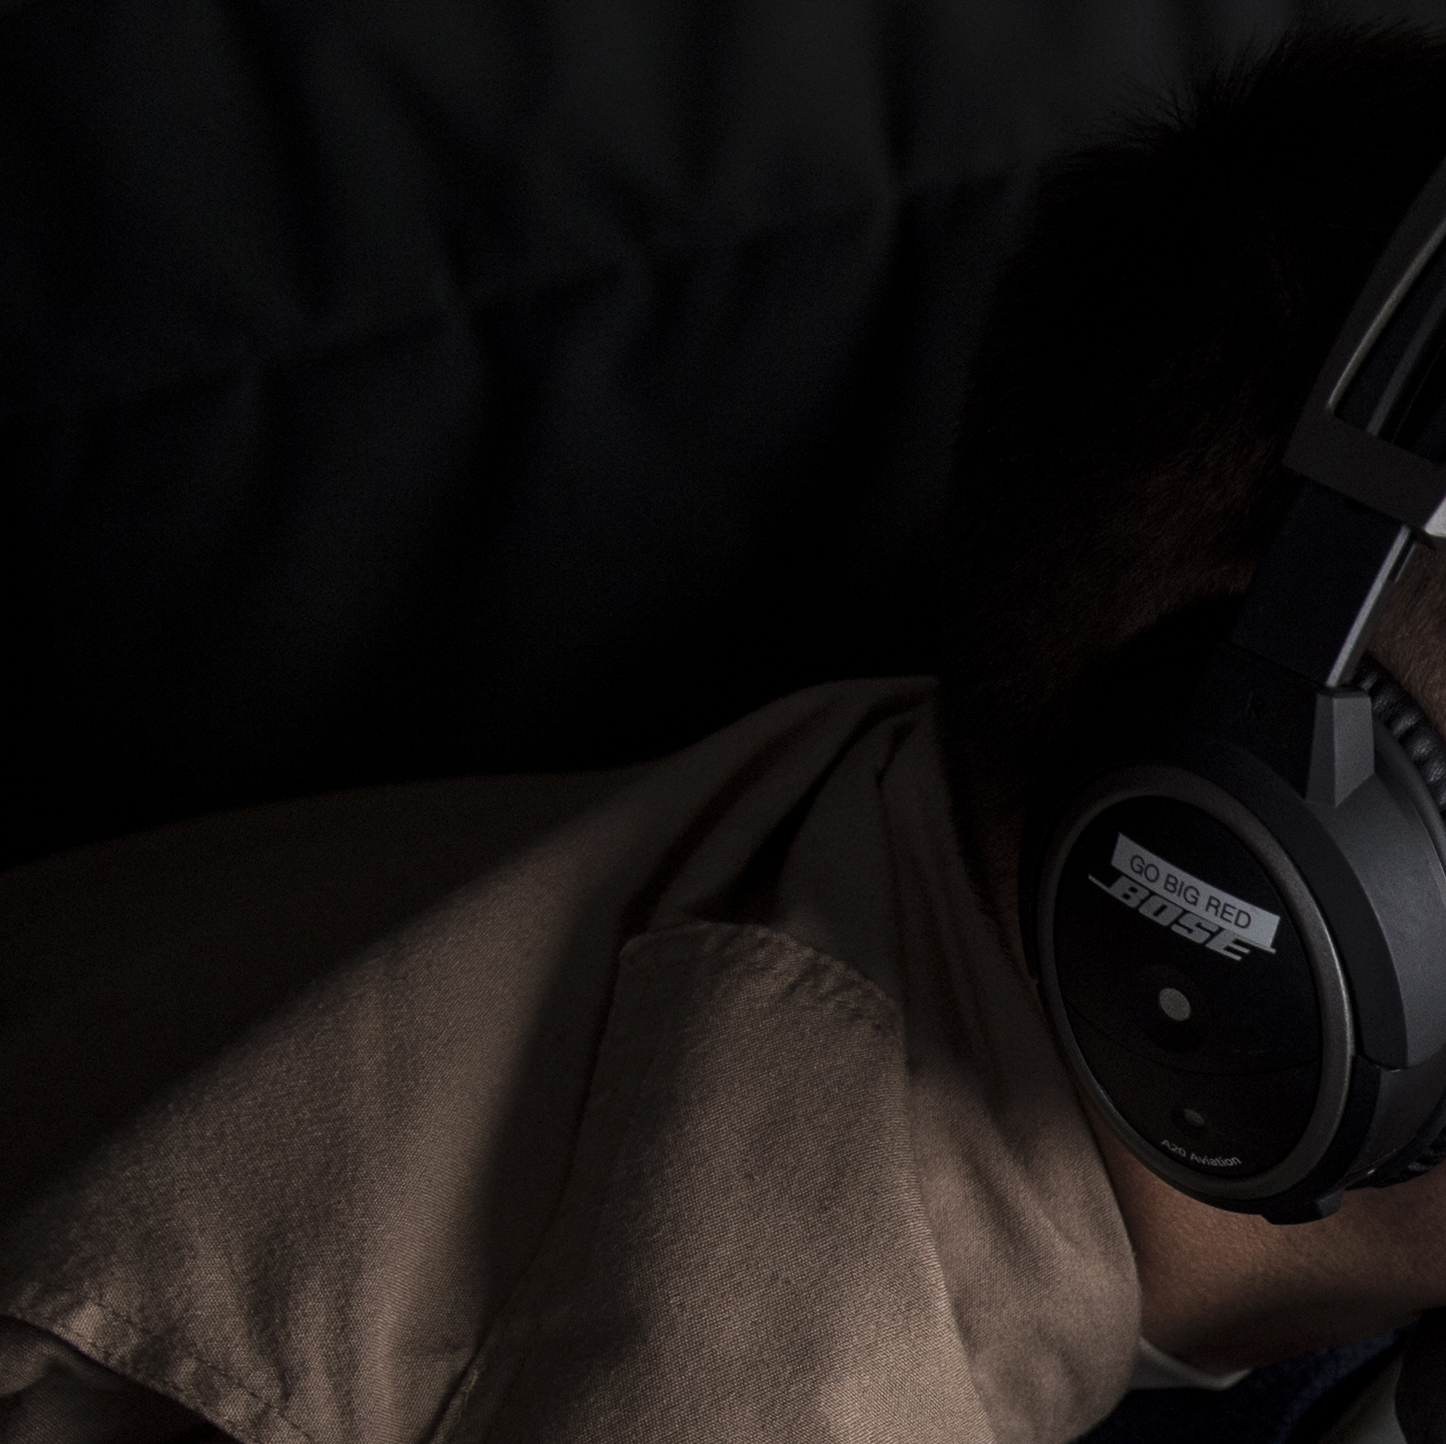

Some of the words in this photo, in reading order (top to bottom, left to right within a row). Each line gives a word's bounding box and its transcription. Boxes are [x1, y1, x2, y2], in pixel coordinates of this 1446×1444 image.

[1088, 873, 1277, 962] BOSE
[1129, 854, 1160, 883] GO
[1163, 873, 1200, 906] BIG
[1205, 895, 1252, 930] RED
[1161, 1139, 1187, 1157] A20
[1189, 1152, 1242, 1168] Aviation
